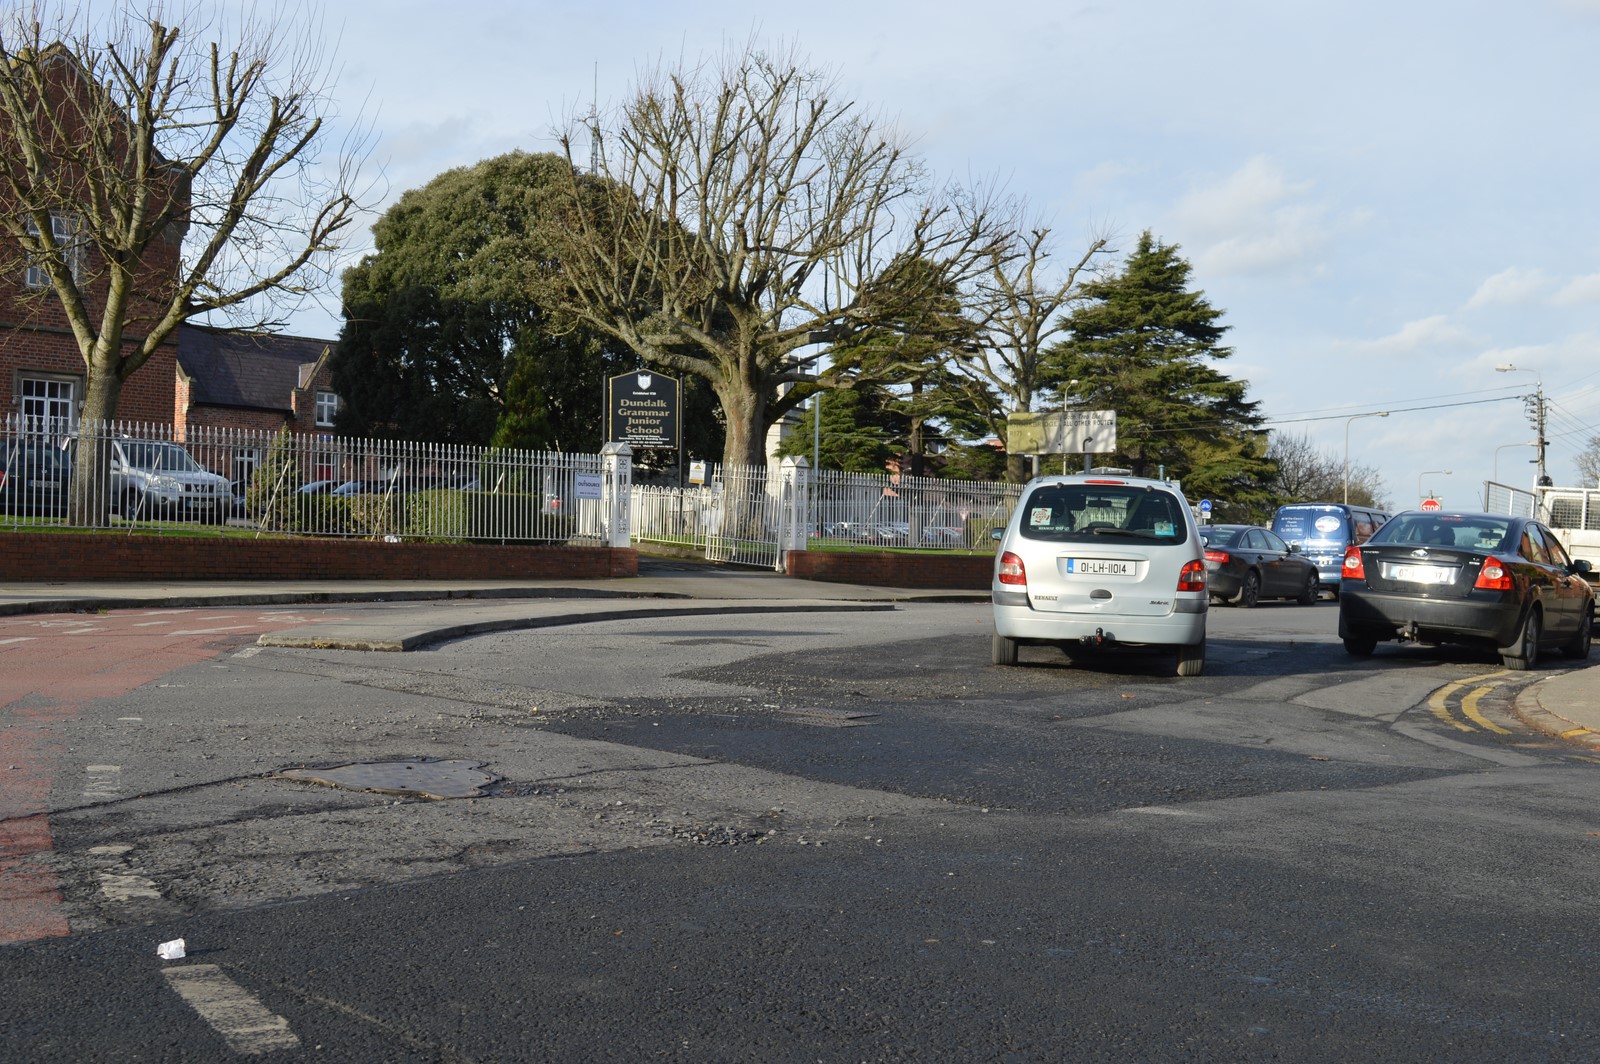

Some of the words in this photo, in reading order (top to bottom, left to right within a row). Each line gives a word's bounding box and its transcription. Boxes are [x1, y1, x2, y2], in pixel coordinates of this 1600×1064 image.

[620, 399, 668, 408] Dundalk
[617, 408, 671, 417] Grammar
[627, 417, 662, 426] Junior
[625, 426, 663, 434] School
[1080, 562, 1127, 574] 01-LH-11014
